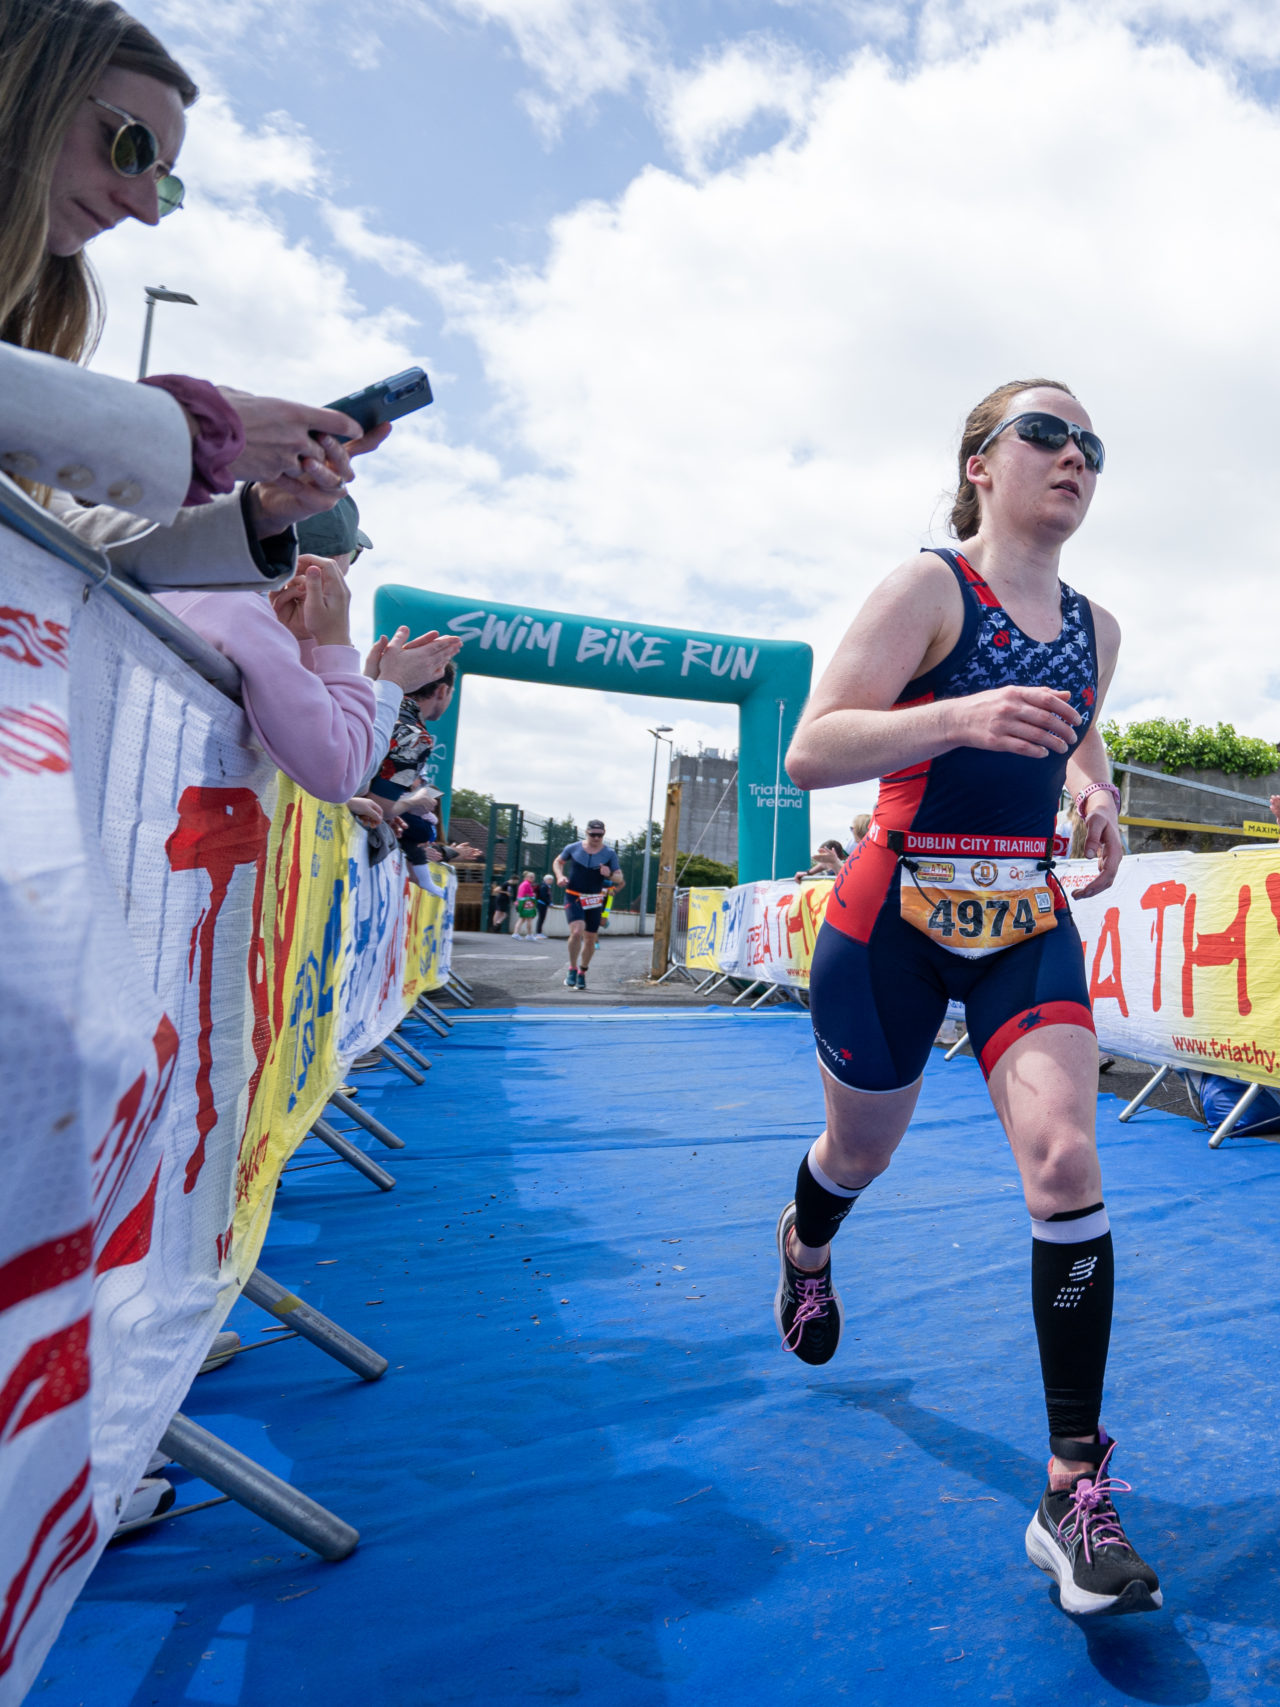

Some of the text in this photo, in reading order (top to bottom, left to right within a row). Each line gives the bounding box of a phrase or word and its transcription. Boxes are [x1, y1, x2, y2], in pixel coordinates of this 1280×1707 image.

[680, 638, 759, 681] RUN
[756, 796, 802, 808] Ireand
[1248, 825, 1280, 835] MAXIM
[907, 835, 956, 850] DUBLIN
[960, 838, 990, 851] CITY
[993, 839, 1046, 853] TRIATHLON
[927, 898, 1037, 938] 4974
